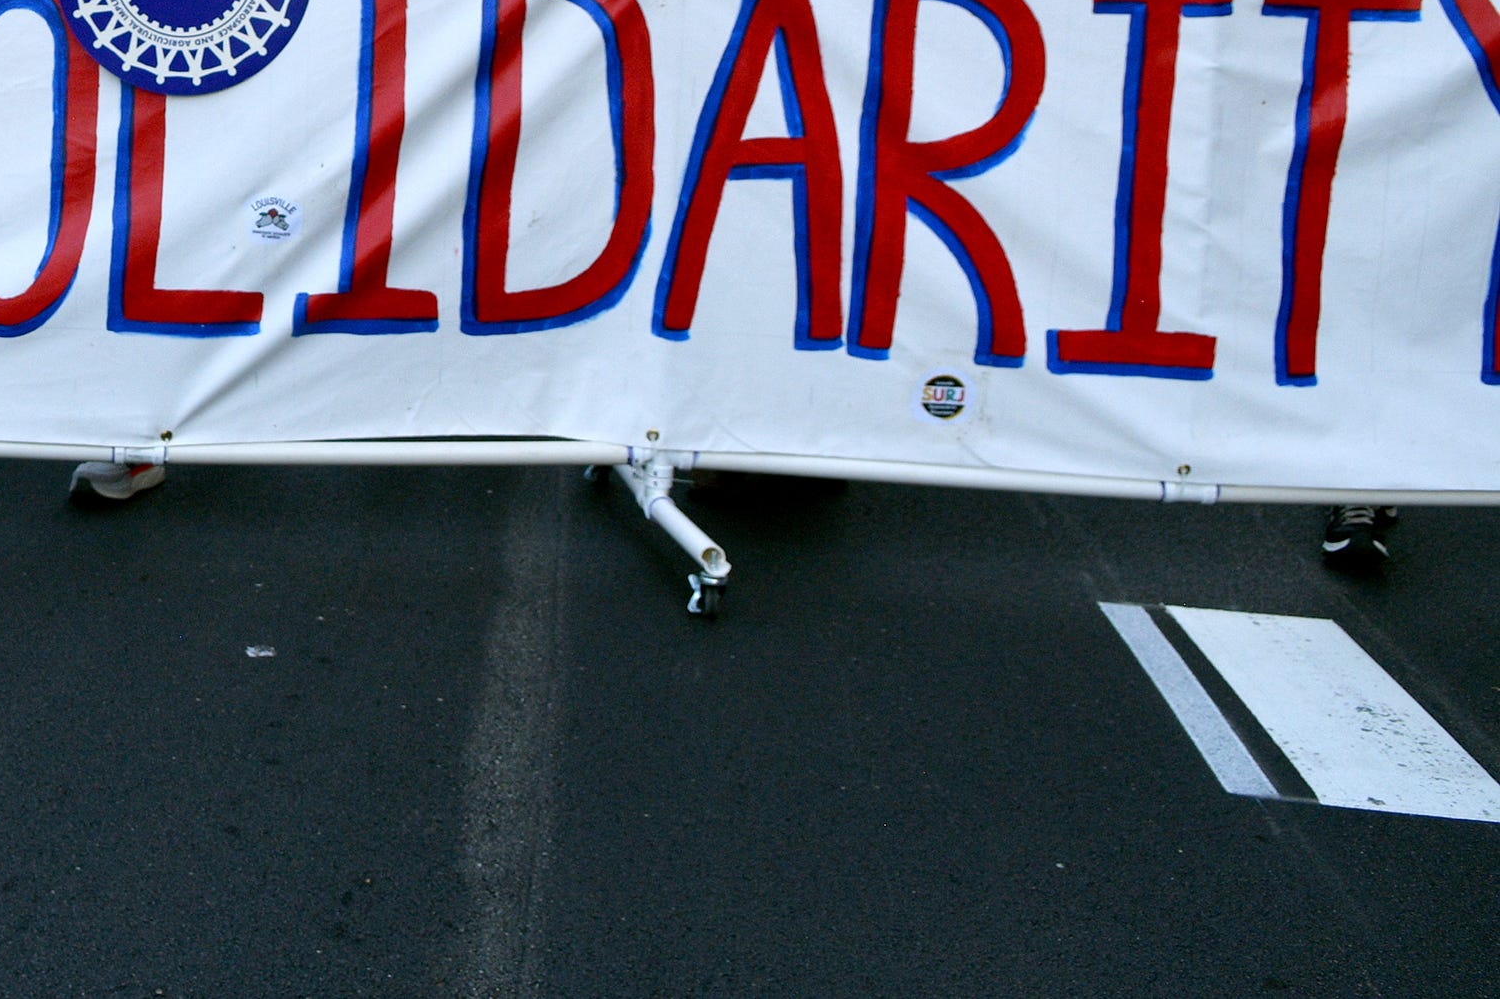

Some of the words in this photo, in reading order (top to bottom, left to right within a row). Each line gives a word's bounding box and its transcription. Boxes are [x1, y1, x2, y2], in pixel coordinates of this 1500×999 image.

[128, 18, 191, 48] AGRICULTURAL
[194, 34, 215, 47] AND
[250, 196, 297, 215] LOUISVILLE
[921, 386, 965, 403] SURJ
